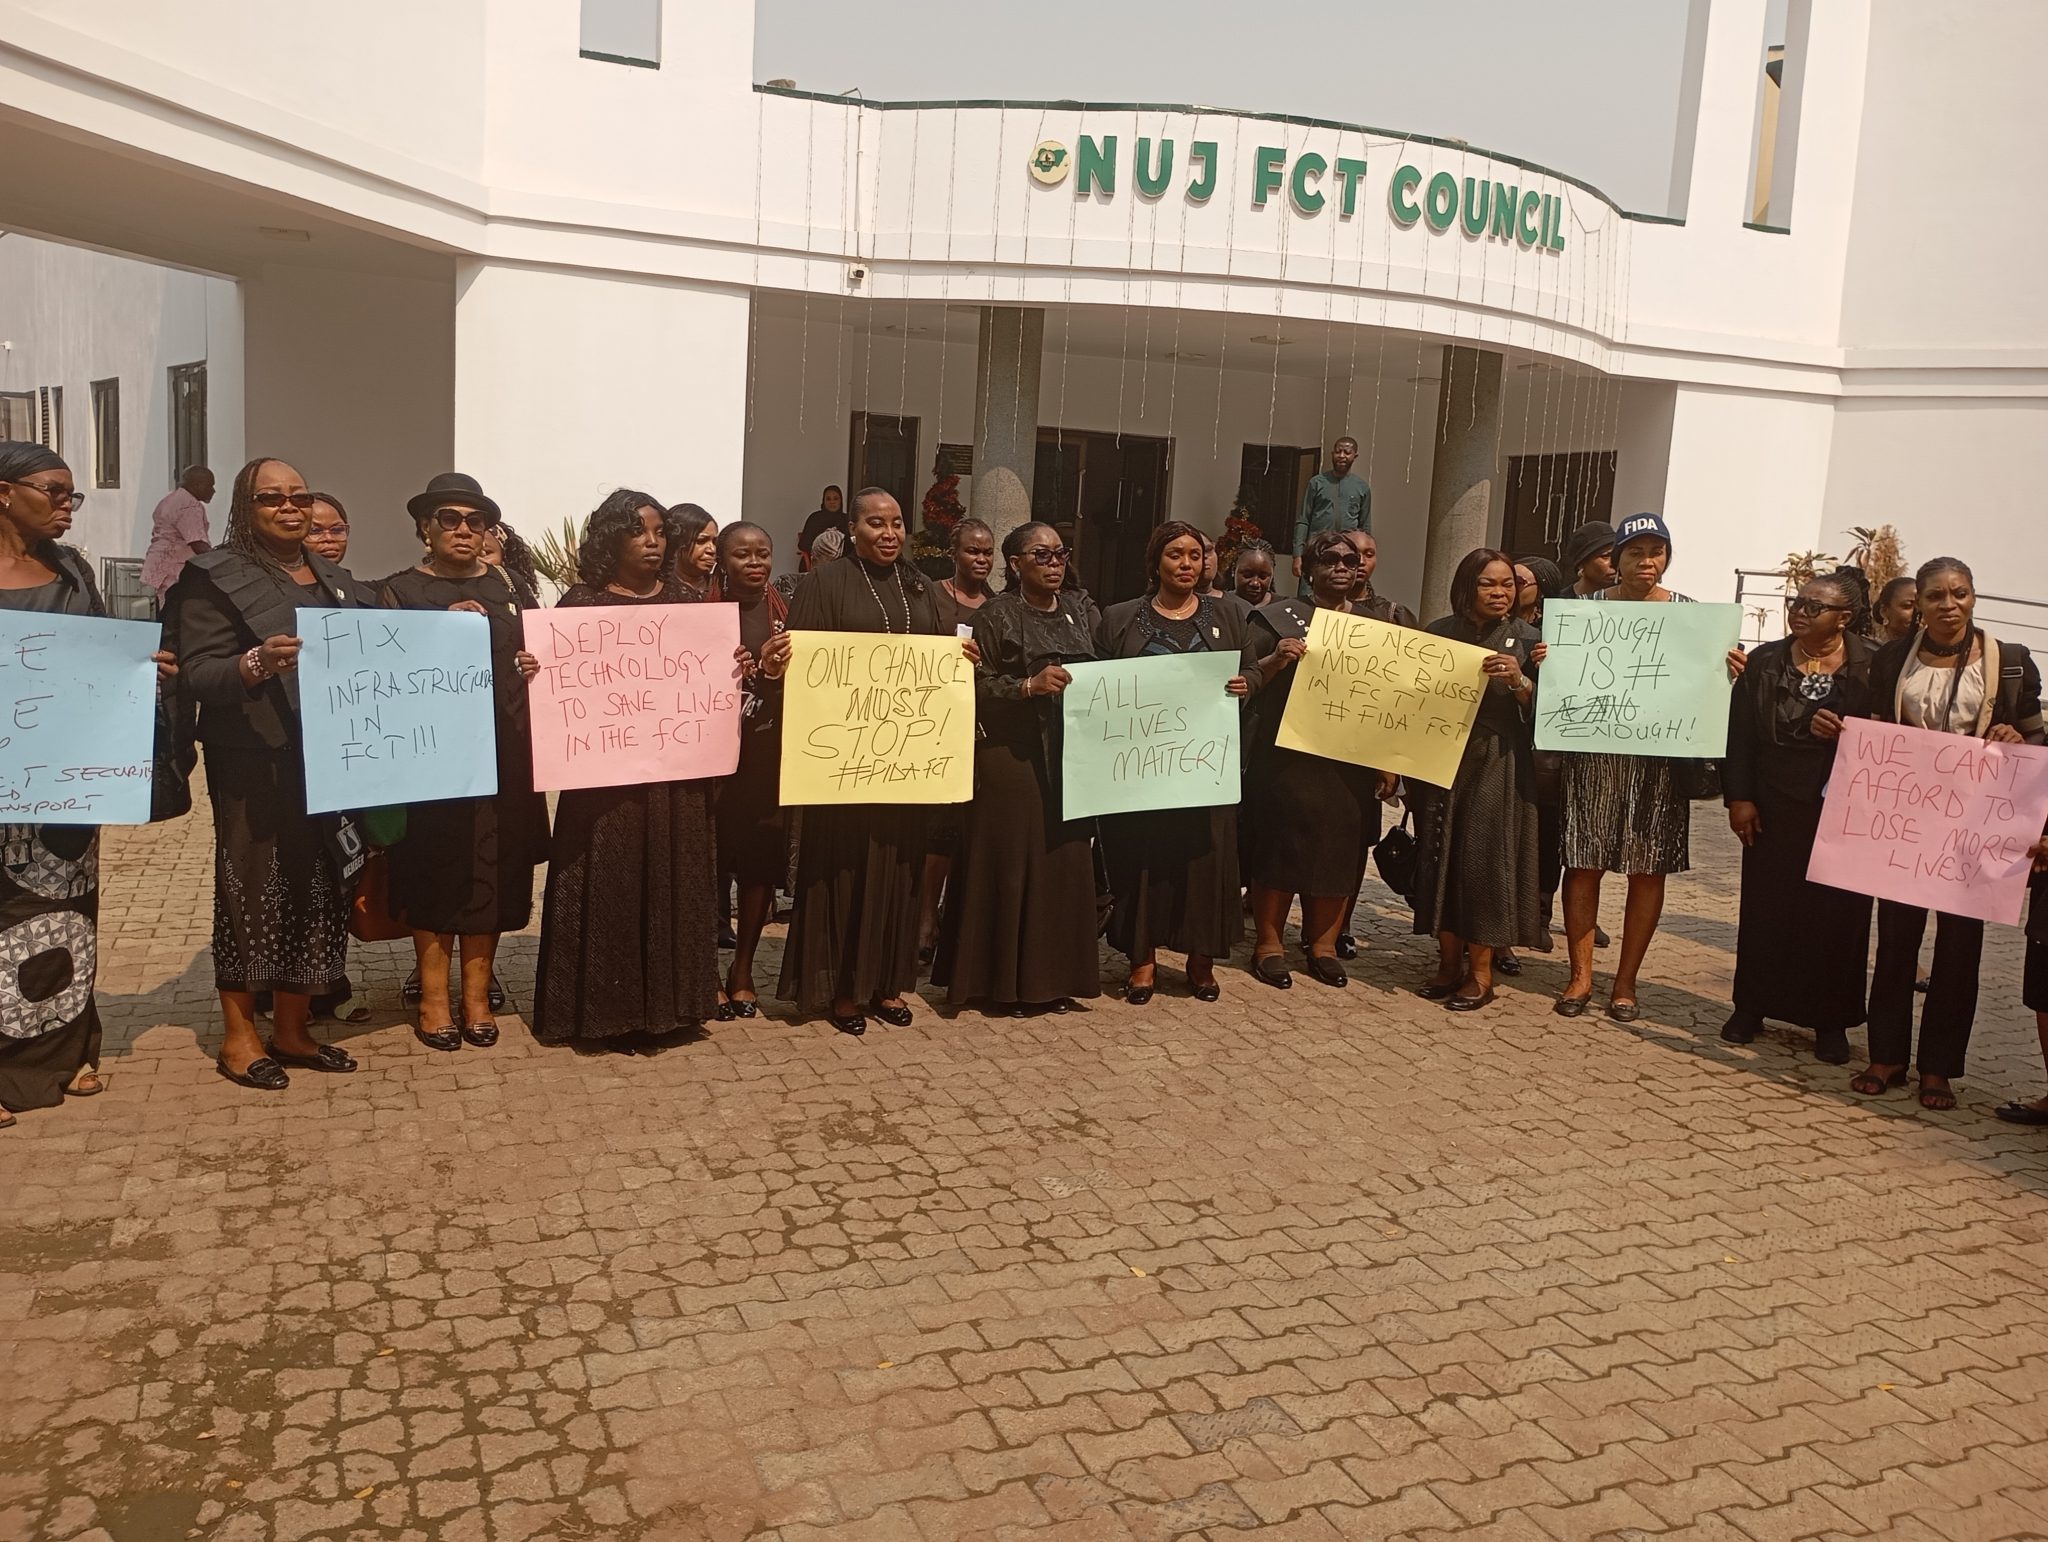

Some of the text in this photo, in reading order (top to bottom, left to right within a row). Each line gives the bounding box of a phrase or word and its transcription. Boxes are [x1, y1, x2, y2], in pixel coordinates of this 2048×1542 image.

[1253, 146, 1367, 216] FCT
[1389, 165, 1565, 252] COUNCIL
[1624, 518, 1658, 536] FIDA
[321, 612, 406, 668] FIX
[549, 614, 669, 661] DEPLOY
[1322, 615, 1455, 672] WE NEED
[1550, 611, 1665, 662] ENOUGH
[544, 650, 710, 694] TECHNOLOGY
[807, 644, 967, 688] ONE CHANCE
[1308, 674, 1330, 695] IN
[1321, 649, 1479, 704] MORE BUSES
[1578, 646, 1670, 690] IS #
[558, 683, 735, 727] TO SAVE LIVES
[1088, 674, 1162, 717] ALL
[349, 704, 381, 741] IN
[566, 733, 591, 762] IN
[599, 724, 639, 753] THE
[801, 708, 951, 759] STOP!
[1103, 706, 1187, 741] LIVES
[1425, 716, 1468, 741] FCT
[1555, 717, 1697, 742] ENOUGH!
[1113, 734, 1229, 785] MATTER!
[1858, 731, 2037, 792] WE CAN'T
[1984, 794, 2015, 824] TO
[1843, 806, 2021, 864] LOSE MORE
[1889, 850, 1982, 888] LIVES!
